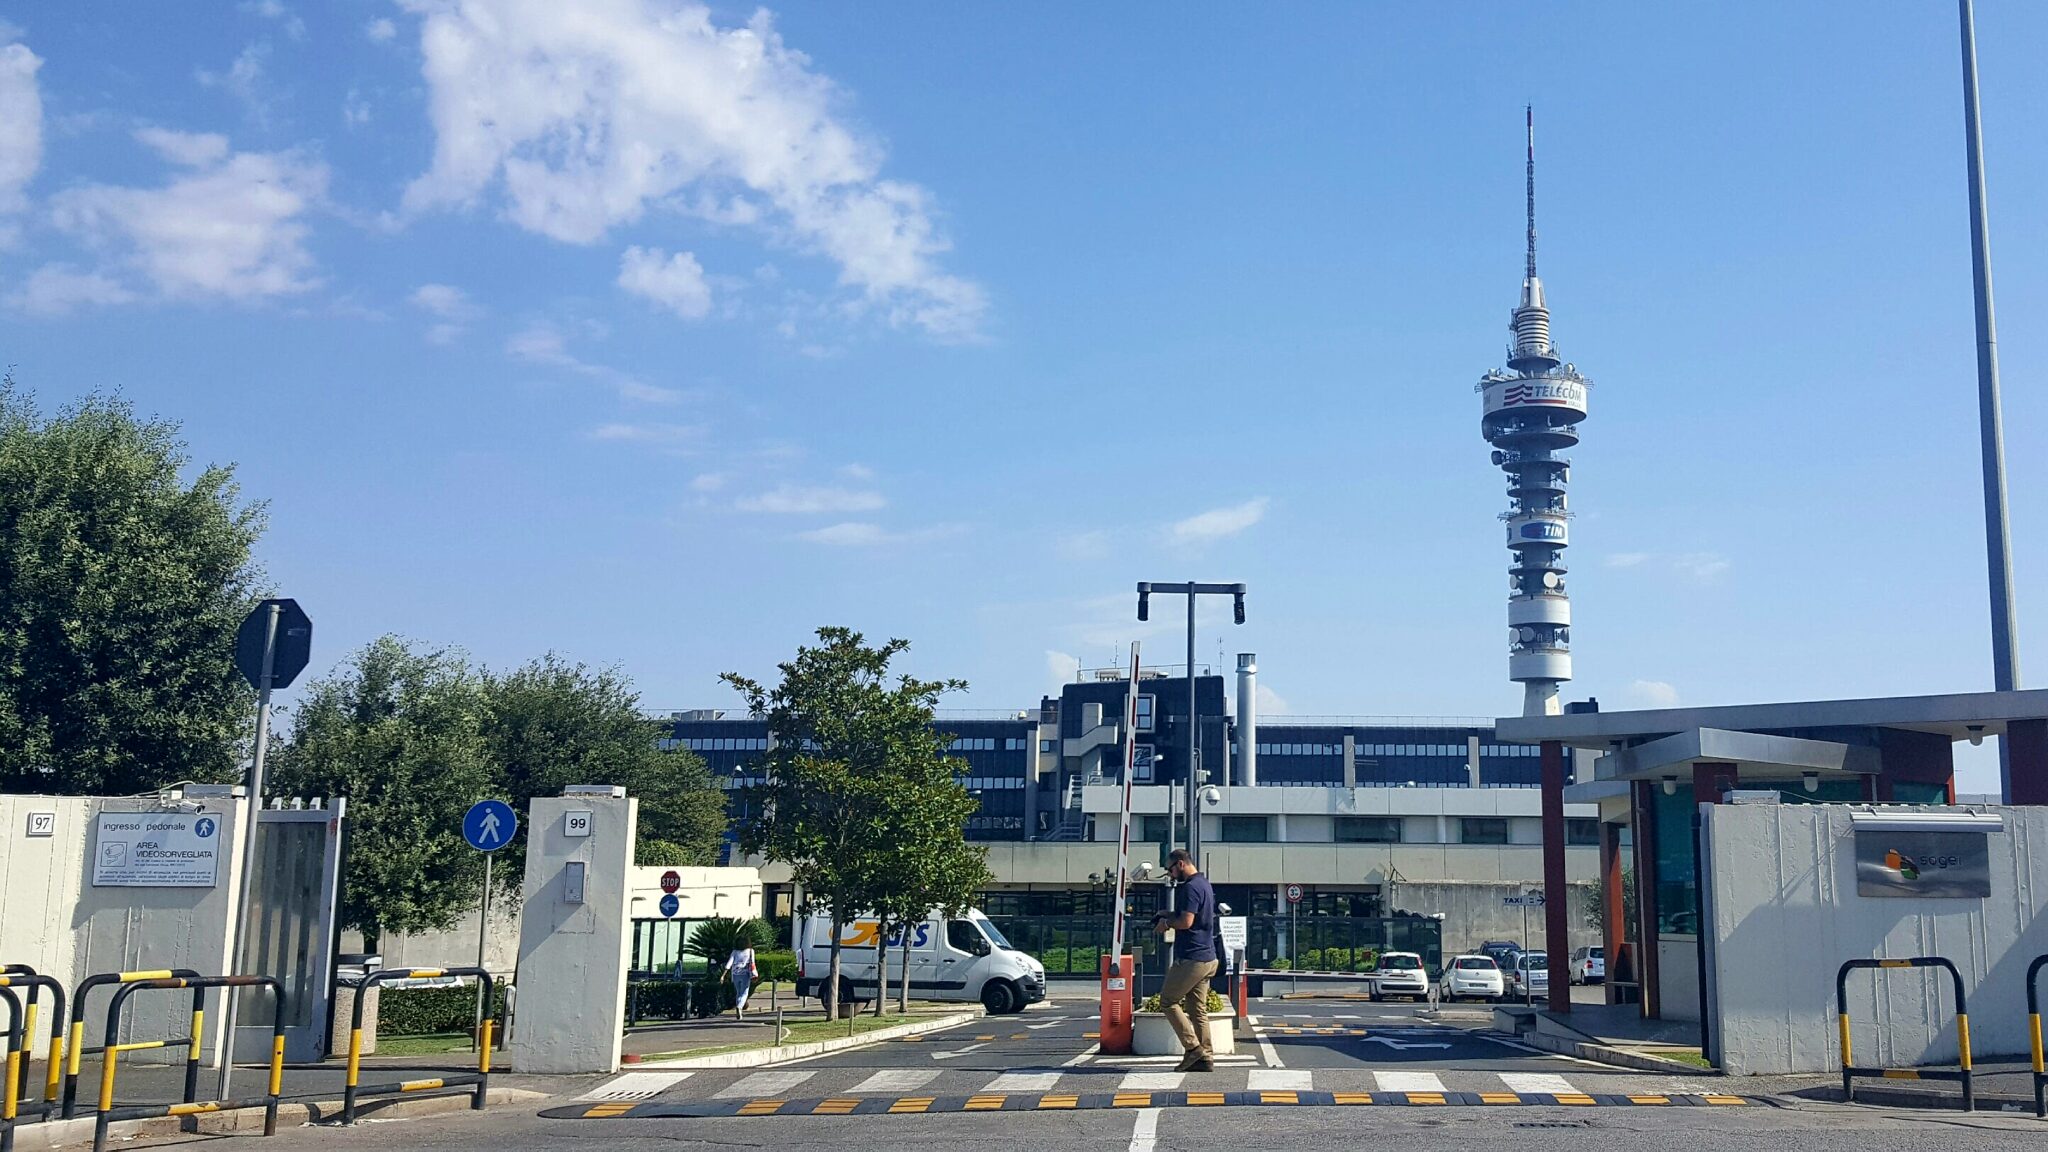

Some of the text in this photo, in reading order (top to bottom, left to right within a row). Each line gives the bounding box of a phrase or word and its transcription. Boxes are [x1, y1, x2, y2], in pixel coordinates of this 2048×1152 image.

[1535, 385, 1581, 401] TELECOM
[1544, 525, 1563, 537] TIM
[35, 817, 50, 830] 97
[103, 821, 186, 831] ingresso pedonale
[570, 818, 586, 829] 99
[136, 850, 213, 858] VIDEOSORVEGLIATA
[661, 878, 679, 887] STOP
